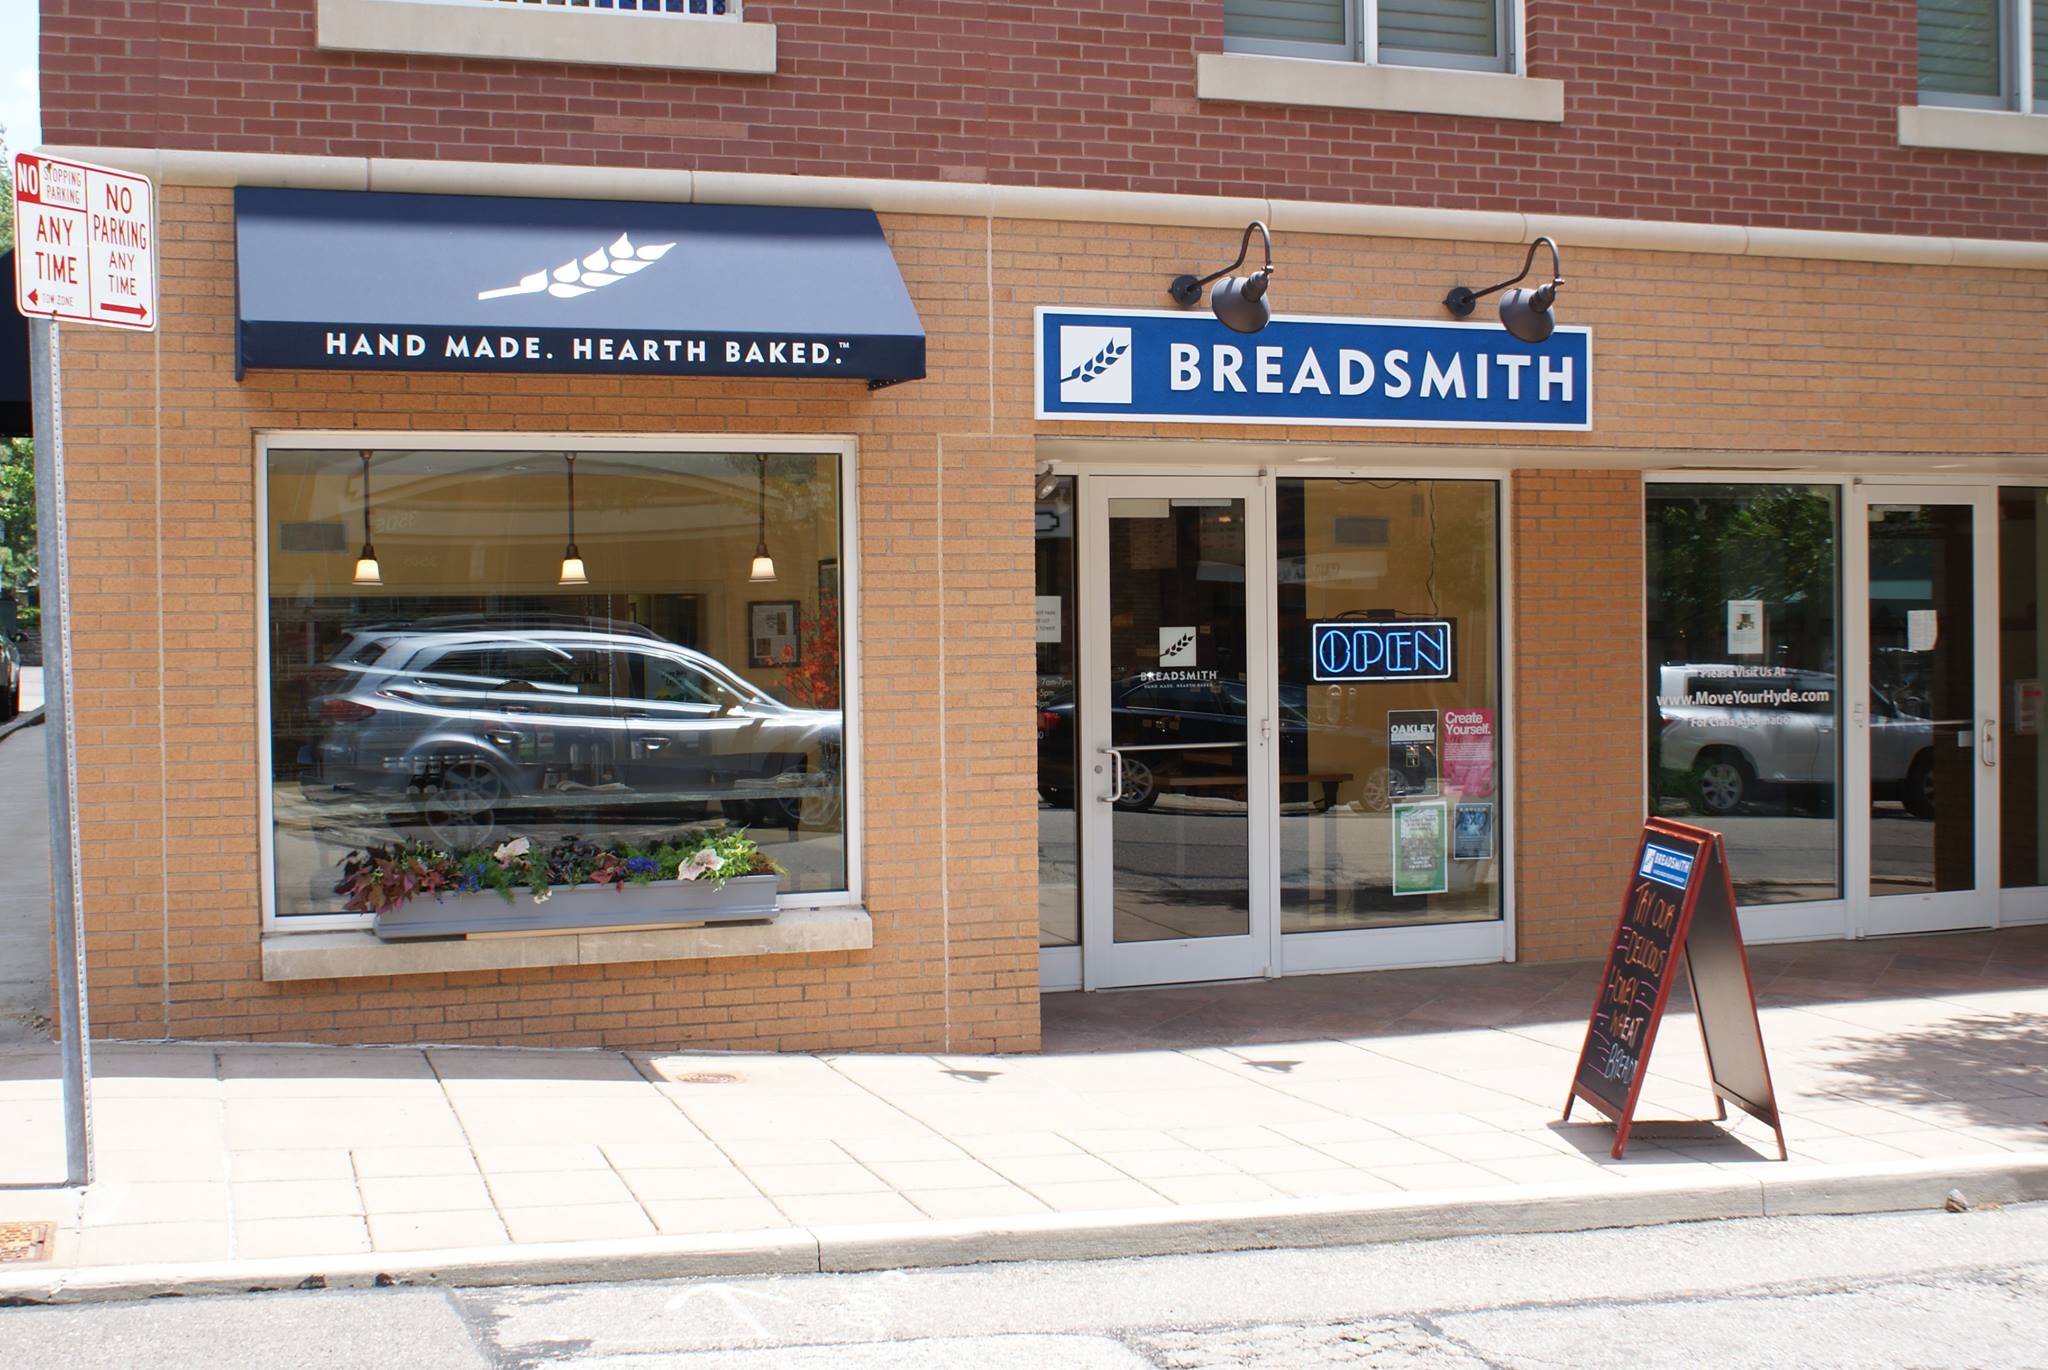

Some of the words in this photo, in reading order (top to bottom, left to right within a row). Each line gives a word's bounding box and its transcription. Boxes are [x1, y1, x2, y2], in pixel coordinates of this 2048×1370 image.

[17, 162, 39, 195] NO
[44, 166, 81, 187] STOPPING
[46, 184, 80, 205] PARKING
[106, 183, 133, 214] NO
[36, 214, 73, 246] ANY
[93, 214, 147, 250] PARKING
[35, 251, 78, 285] TIME
[108, 251, 135, 271] ANY
[108, 274, 137, 296] TIME
[41, 292, 55, 304] TOW
[56, 294, 74, 307] ZONE
[325, 332, 427, 357] HAND
[445, 336, 553, 360] MADE.
[572, 338, 707, 363] HEARTH
[1169, 342, 1574, 402] BREADSMITH
[1319, 628, 1444, 673] OPEN
[1140, 670, 1217, 682] BREADSMITH
[1735, 665, 1758, 677] Visit
[1759, 666, 1773, 677] Us
[1774, 666, 1786, 677] At
[1656, 687, 1830, 707] www.MoveYourHyde.com
[1445, 711, 1483, 724] Create
[1690, 717, 1707, 728] For
[1391, 723, 1436, 734] OAKLEY
[1445, 723, 1491, 735] Yourself.
[1633, 881, 1656, 928] TRY
[1651, 898, 1676, 937] OUR
[1609, 1008, 1644, 1049] WHEAT
